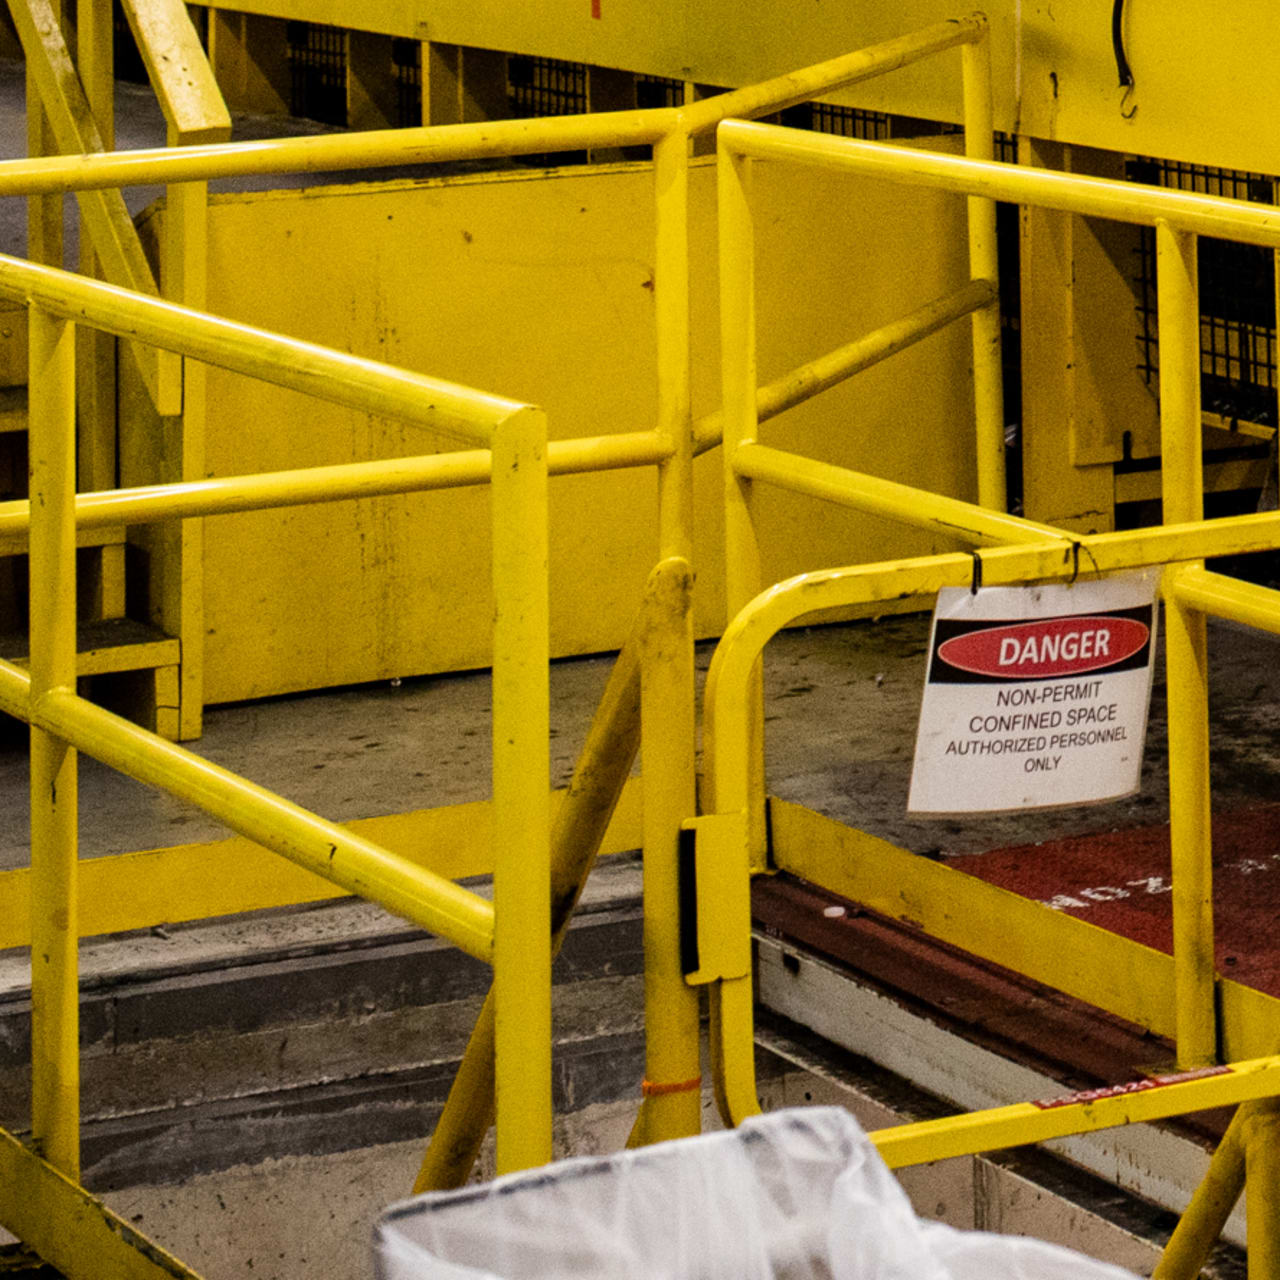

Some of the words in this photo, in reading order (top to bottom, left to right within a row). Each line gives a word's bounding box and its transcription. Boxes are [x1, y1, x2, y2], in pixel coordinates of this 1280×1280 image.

[999, 629, 1110, 666] DANGER
[996, 681, 1103, 707] NON-PERMIT
[969, 710, 1062, 734] CONFINED
[1066, 703, 1118, 726] SPACE
[945, 736, 1047, 756] AUTHORIZED
[1049, 726, 1128, 749] PERSONNEL
[1024, 755, 1062, 773] ONLY
